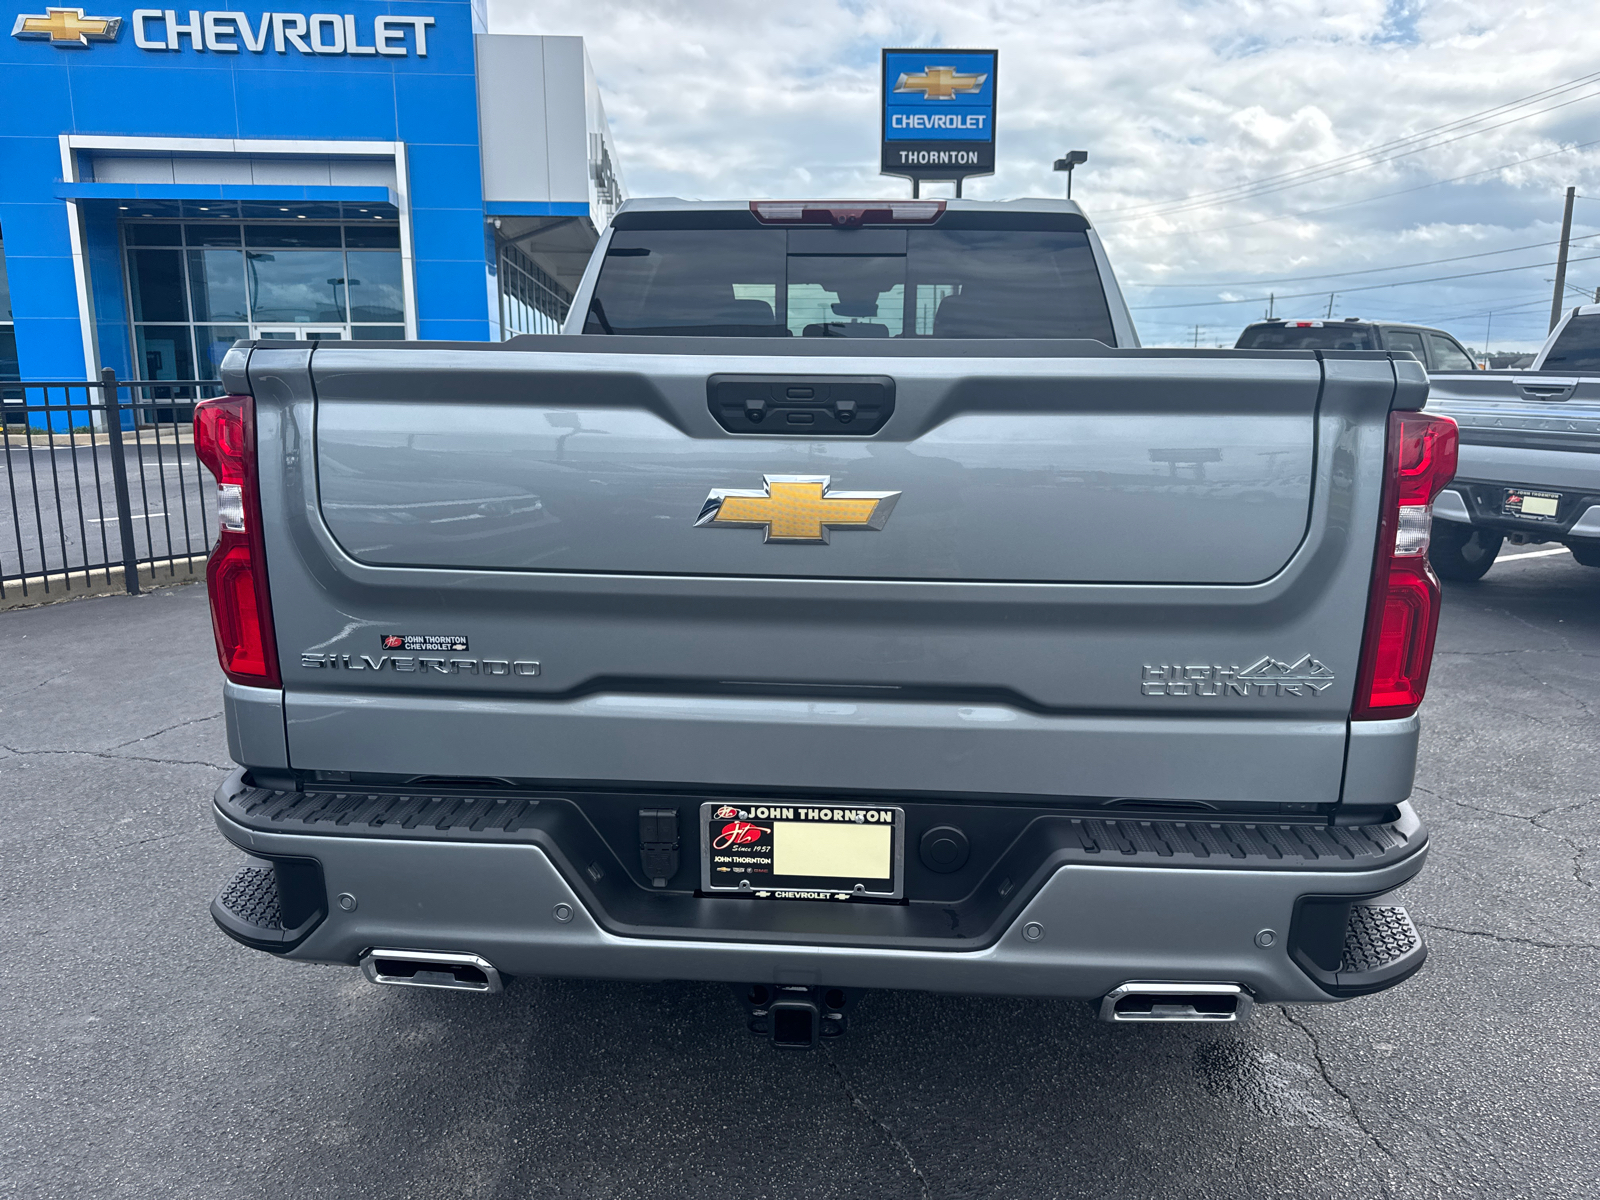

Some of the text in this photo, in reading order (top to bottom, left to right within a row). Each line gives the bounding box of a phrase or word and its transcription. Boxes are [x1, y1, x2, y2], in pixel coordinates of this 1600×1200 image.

[132, 9, 436, 56] CHEVROLET
[892, 114, 986, 129] CHEVROLET
[899, 151, 978, 164] THORNTON
[404, 635, 466, 644] JOHN THORNTON
[301, 652, 542, 677] SILVERADO
[1142, 665, 1240, 681] HIGH
[1141, 682, 1333, 697] COUNTRY
[748, 806, 794, 820] JOHN
[798, 808, 892, 823] THORNTON
[731, 844, 751, 852] Since
[714, 855, 771, 865] JOHN THORNTON
[775, 891, 831, 900] CHEVROLET
